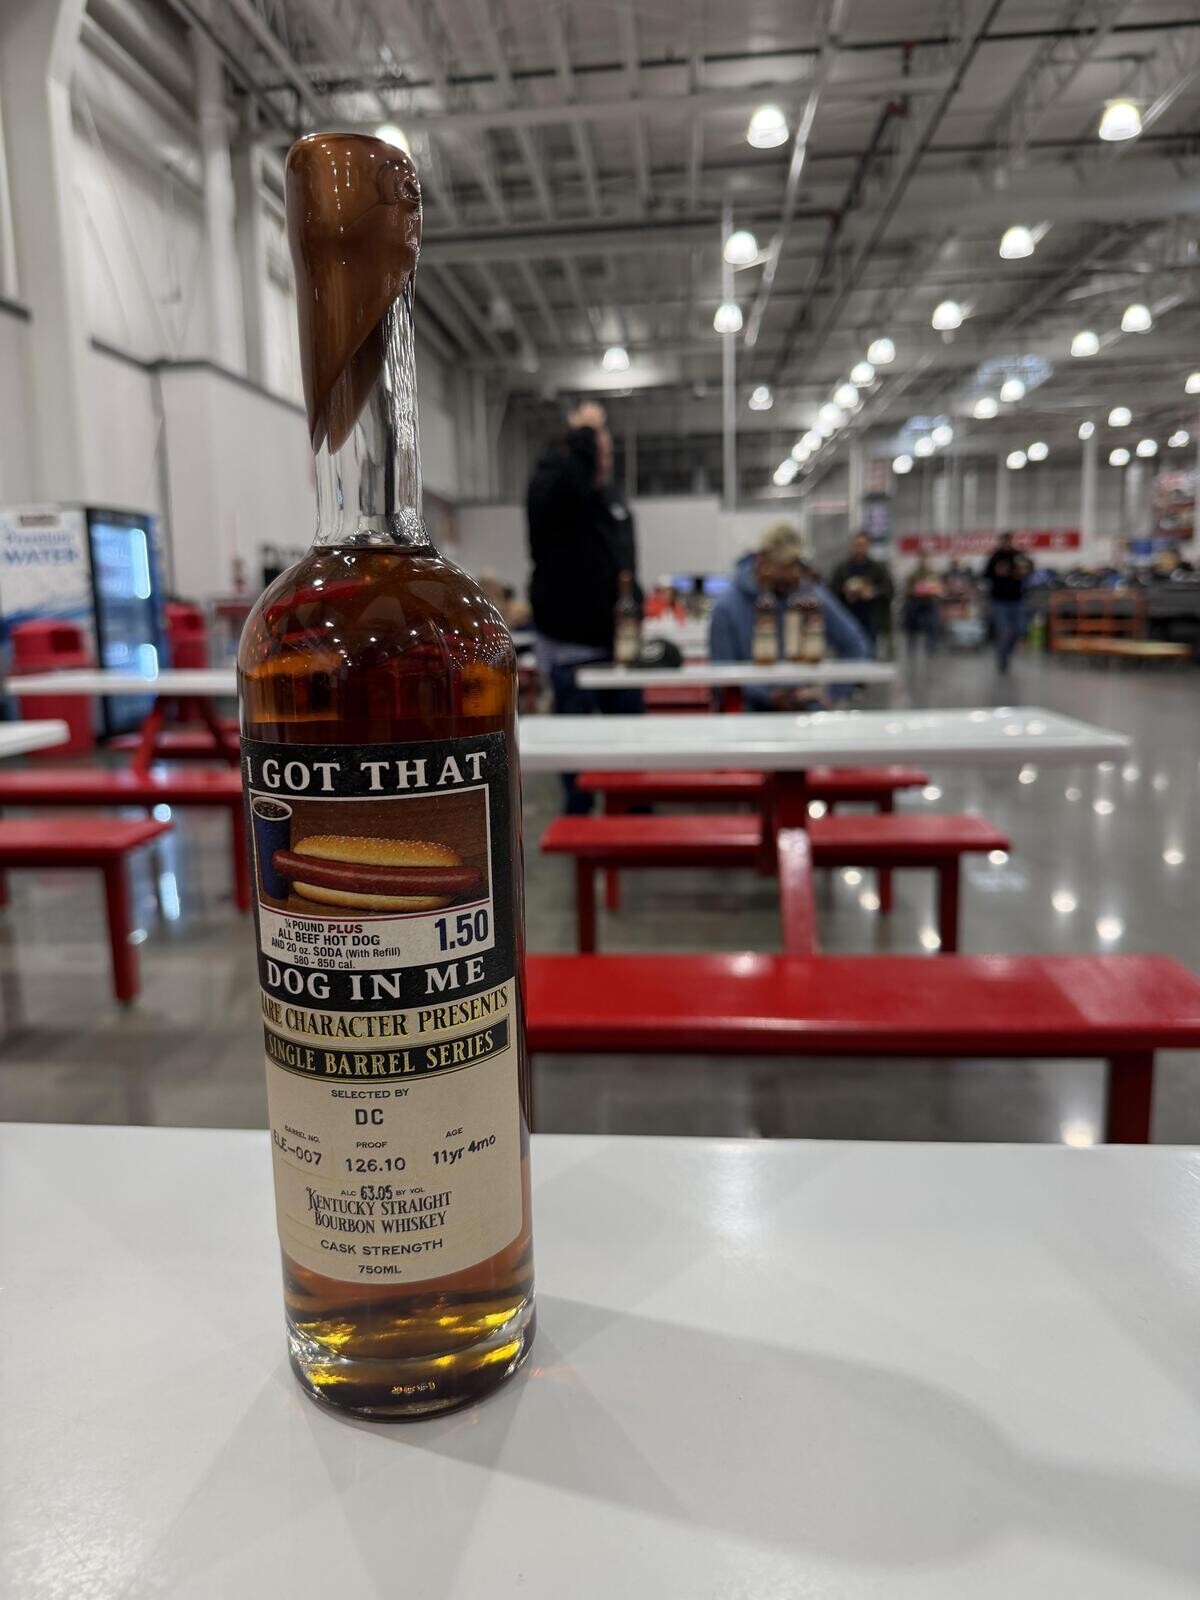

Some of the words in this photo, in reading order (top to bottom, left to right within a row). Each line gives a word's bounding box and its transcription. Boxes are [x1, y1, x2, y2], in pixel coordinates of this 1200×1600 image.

[246, 756, 253, 784] I
[262, 759, 341, 791] GOT
[360, 751, 487, 791] THAT
[292, 921, 324, 933] POUND
[327, 924, 363, 934] PLUS
[434, 909, 489, 952] 1.50
[278, 928, 293, 941] ALL
[295, 933, 320, 944] BEEF
[324, 935, 348, 946] HOT
[352, 934, 380, 946] DOG
[271, 937, 285, 949] AND
[286, 942, 297, 953] 20
[299, 947, 311, 955] oz.
[313, 947, 343, 957] SODA
[345, 948, 370, 959] (With
[373, 947, 401, 957] Refill)
[294, 955, 309, 966] 580
[318, 958, 335, 968] 850
[338, 960, 356, 969] cal.
[266, 959, 331, 999] DOG
[349, 973, 402, 1001] IN
[424, 956, 485, 994] ME
[285, 1007, 408, 1038] CHARACTER
[418, 986, 508, 1032] PRESENTS
[268, 1034, 316, 1071] SINGLE
[325, 1051, 415, 1076] BARREL
[426, 1030, 494, 1070] SERIES
[331, 1089, 391, 1099] SELECTED
[395, 1088, 410, 1097] BY
[355, 1109, 384, 1125] DC
[284, 1124, 306, 1139] BARREL
[308, 1134, 321, 1143] NO.
[445, 1127, 464, 1138] AGE
[356, 1141, 387, 1149] PROOF
[432, 1147, 465, 1165] 11yr
[468, 1134, 496, 1153] 4mo
[345, 1157, 406, 1173] 126.10
[306, 1186, 376, 1215] KENTUCKY
[381, 1191, 452, 1216] STRAIGHT
[340, 1189, 357, 1197] ALC
[360, 1185, 393, 1201] 63.05
[409, 1187, 425, 1195] VOL
[314, 1210, 375, 1233] BOURBON
[381, 1211, 447, 1234] WHISKEY
[320, 1239, 357, 1254] CASK
[362, 1238, 443, 1256] STRENGTH
[358, 1264, 402, 1274] 750ML
